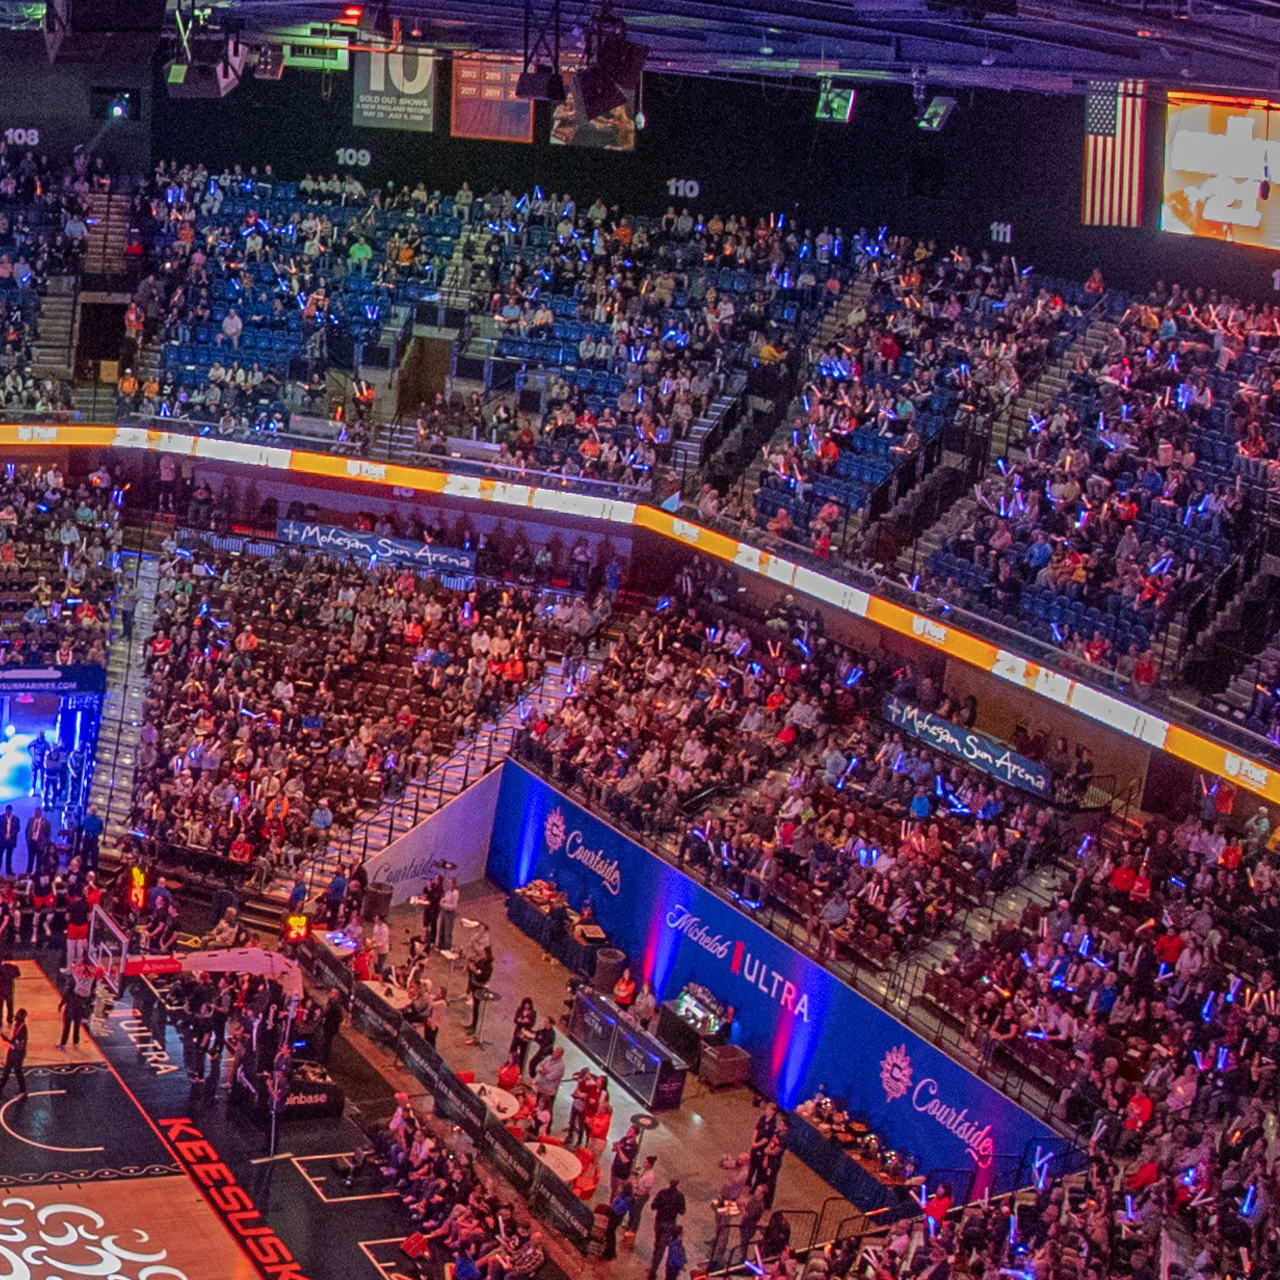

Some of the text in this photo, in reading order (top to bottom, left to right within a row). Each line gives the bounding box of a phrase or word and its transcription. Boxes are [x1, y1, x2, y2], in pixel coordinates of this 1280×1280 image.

[4, 128, 38, 145] 108
[334, 147, 370, 166] 109
[666, 178, 700, 198] 110
[990, 221, 1012, 243] 111
[302, 524, 471, 568] Mohegan Sun Arena
[901, 704, 1046, 790] Mohegan Sun Arena
[565, 830, 621, 896] Courtside
[665, 903, 810, 1023] Michelob ULTRA
[119, 1020, 180, 1076] ULTRA
[287, 1092, 328, 1106] inbase
[912, 1077, 995, 1169] Courtside
